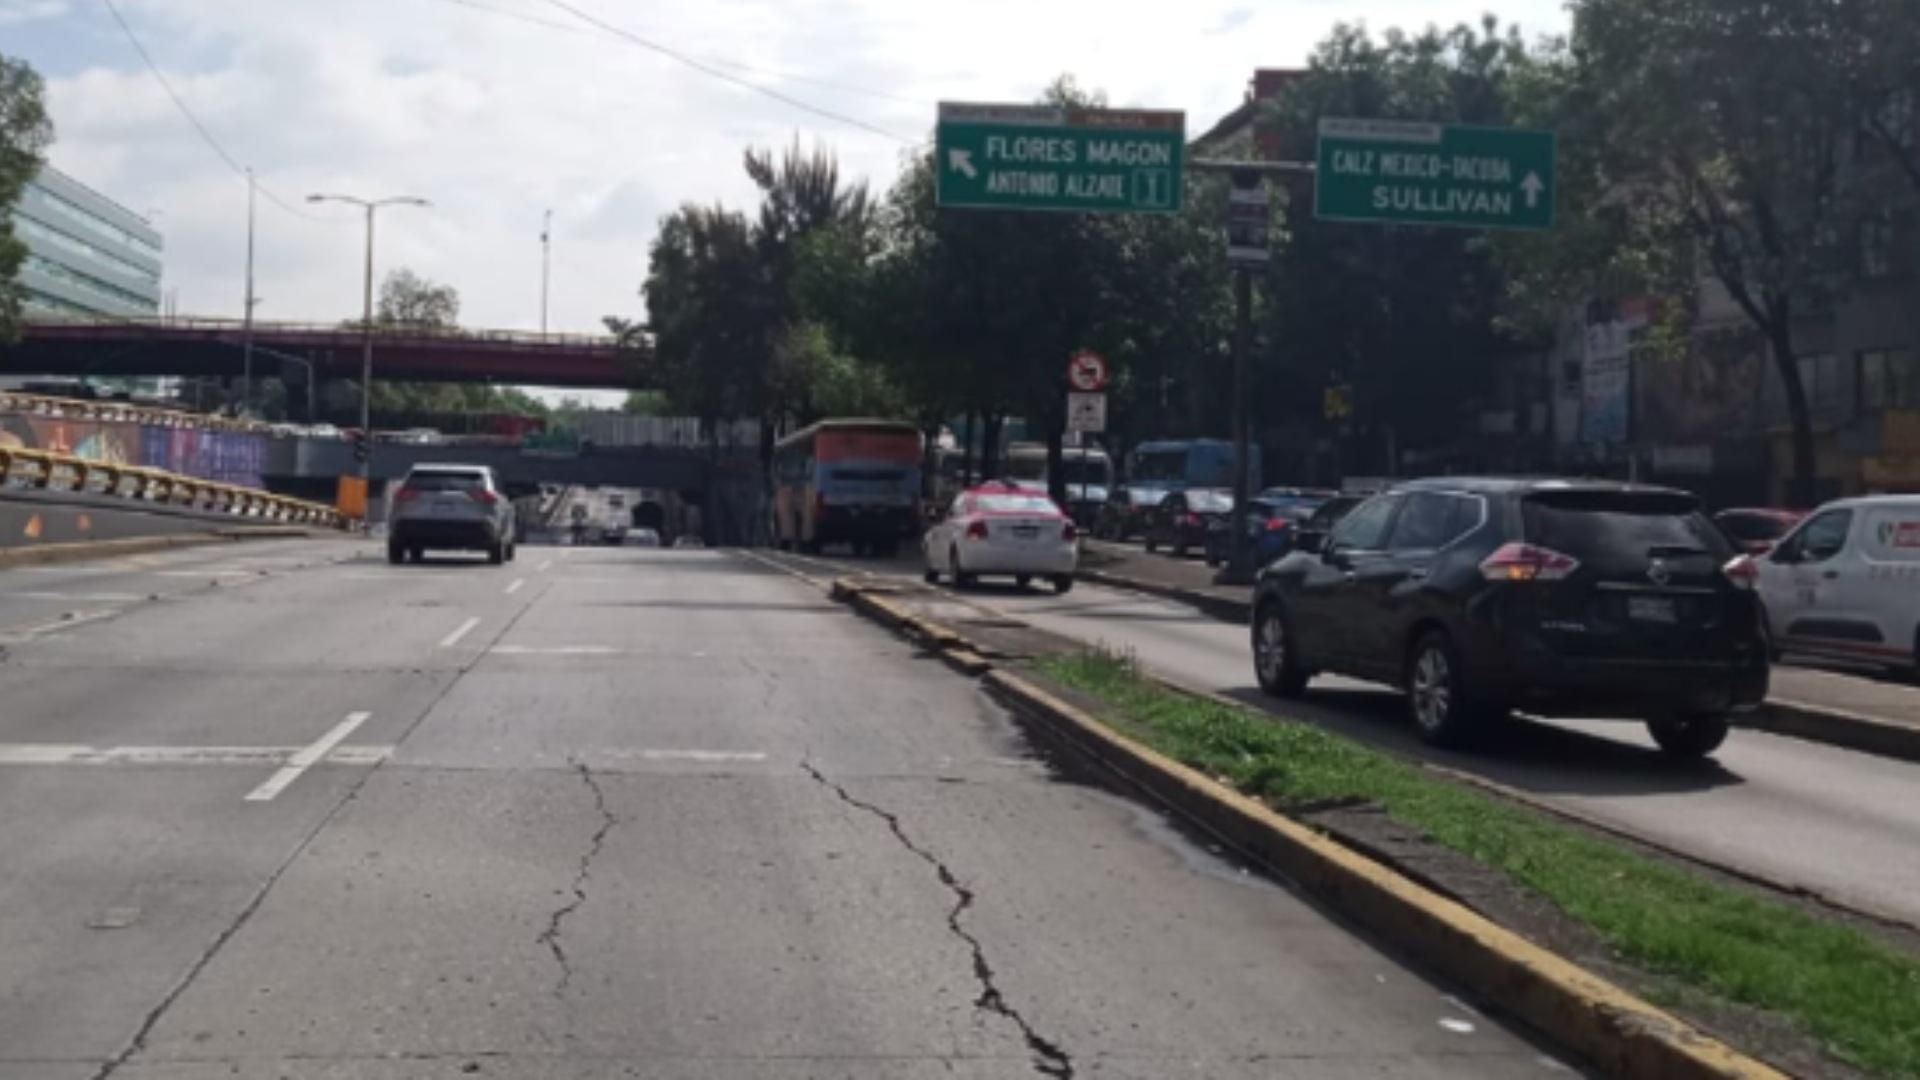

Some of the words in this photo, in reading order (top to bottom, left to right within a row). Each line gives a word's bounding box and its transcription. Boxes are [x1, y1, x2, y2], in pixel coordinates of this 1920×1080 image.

[986, 136, 1077, 162] FLORES
[1087, 139, 1171, 166] MAGON
[986, 169, 1059, 196] ANTONIO
[1064, 173, 1125, 199] ALZATE
[1372, 184, 1511, 214] SULLIVAN
